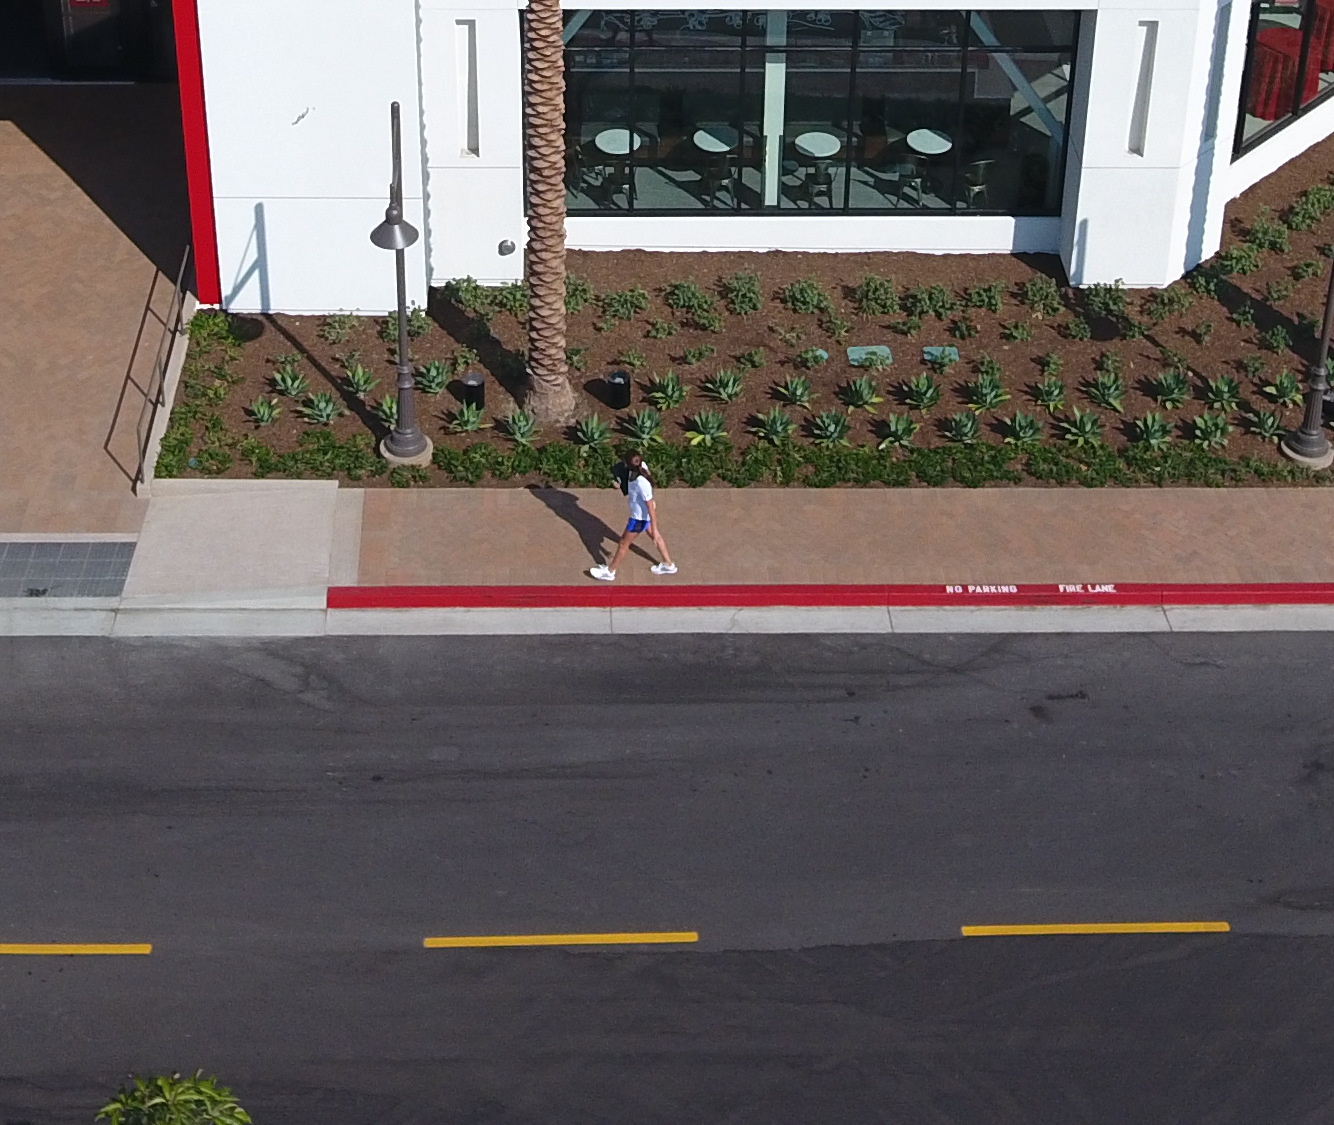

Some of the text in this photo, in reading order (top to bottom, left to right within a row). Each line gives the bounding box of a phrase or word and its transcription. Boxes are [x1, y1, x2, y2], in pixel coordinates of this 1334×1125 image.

[945, 584, 1117, 594] NO PARKING FIRE LANE
